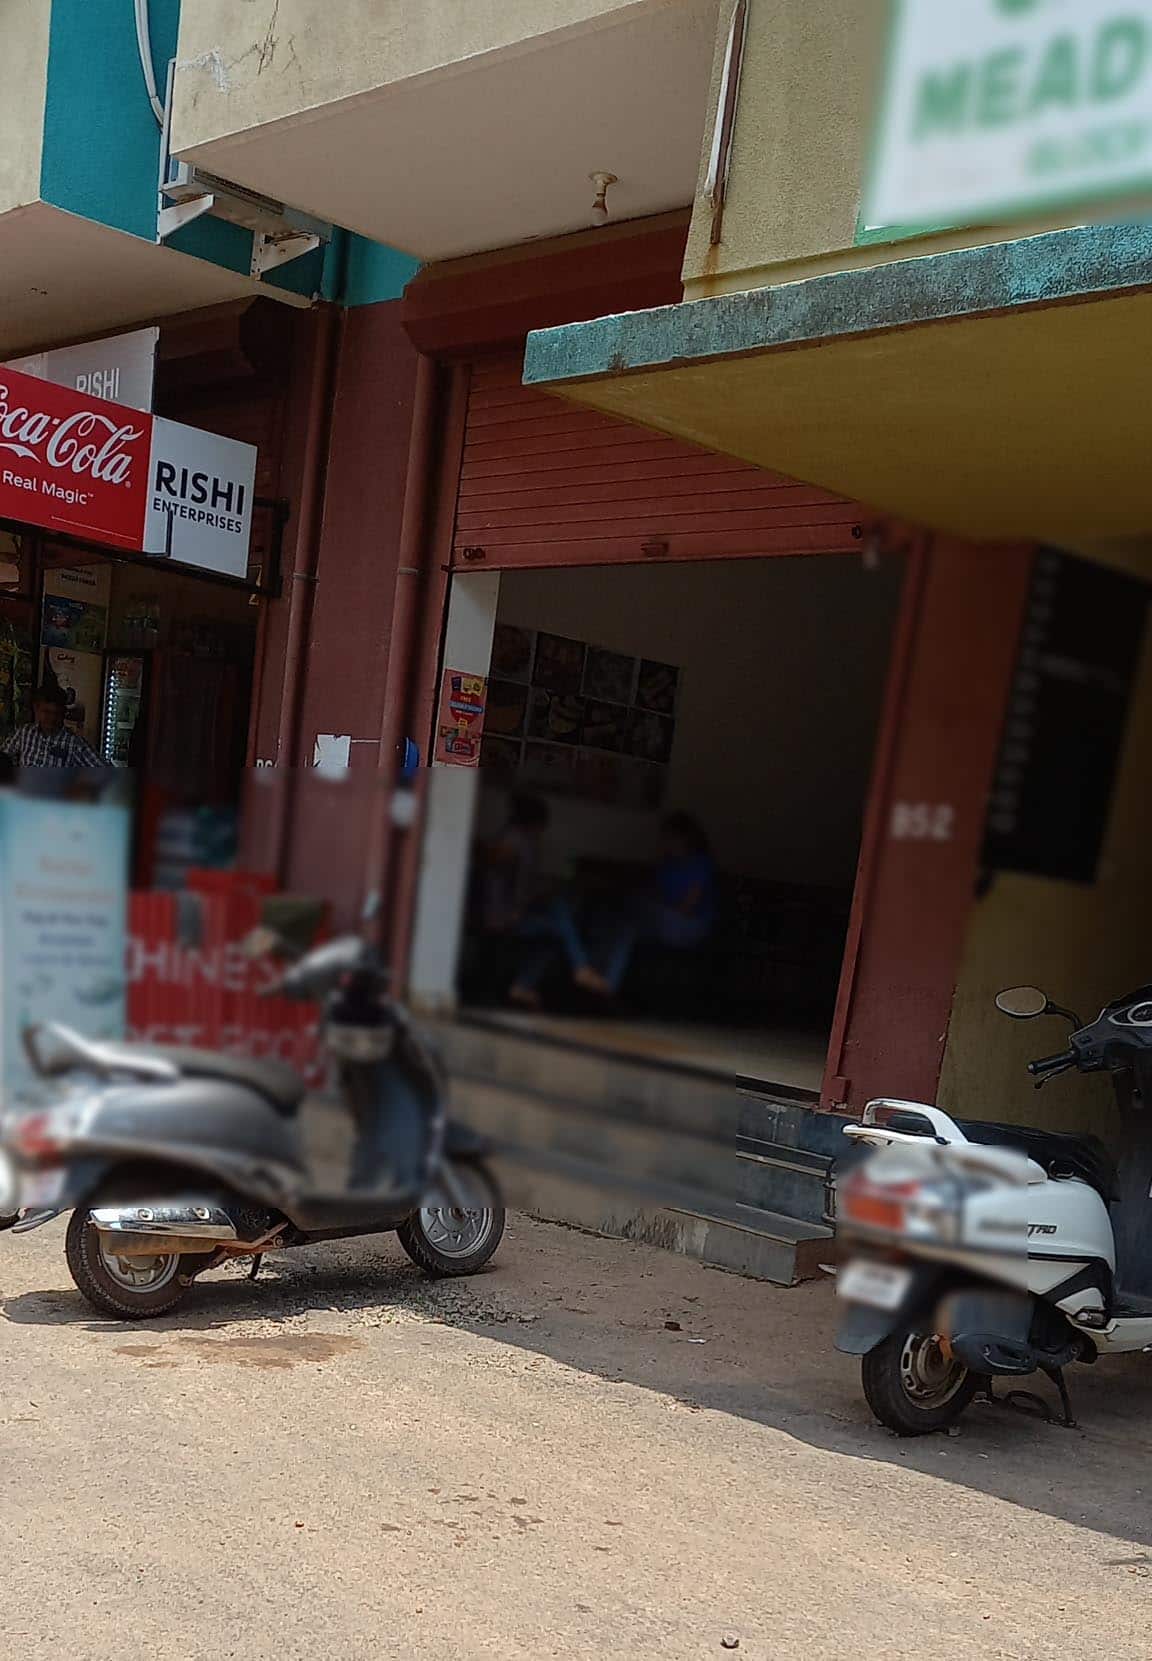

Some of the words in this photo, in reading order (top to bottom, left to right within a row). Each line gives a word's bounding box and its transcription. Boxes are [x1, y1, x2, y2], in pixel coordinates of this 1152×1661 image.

[0, 385, 144, 485] ca-Cola
[3, 470, 37, 492] Real
[155, 460, 245, 515] RISHI
[153, 497, 242, 534] ENTERPRISES
